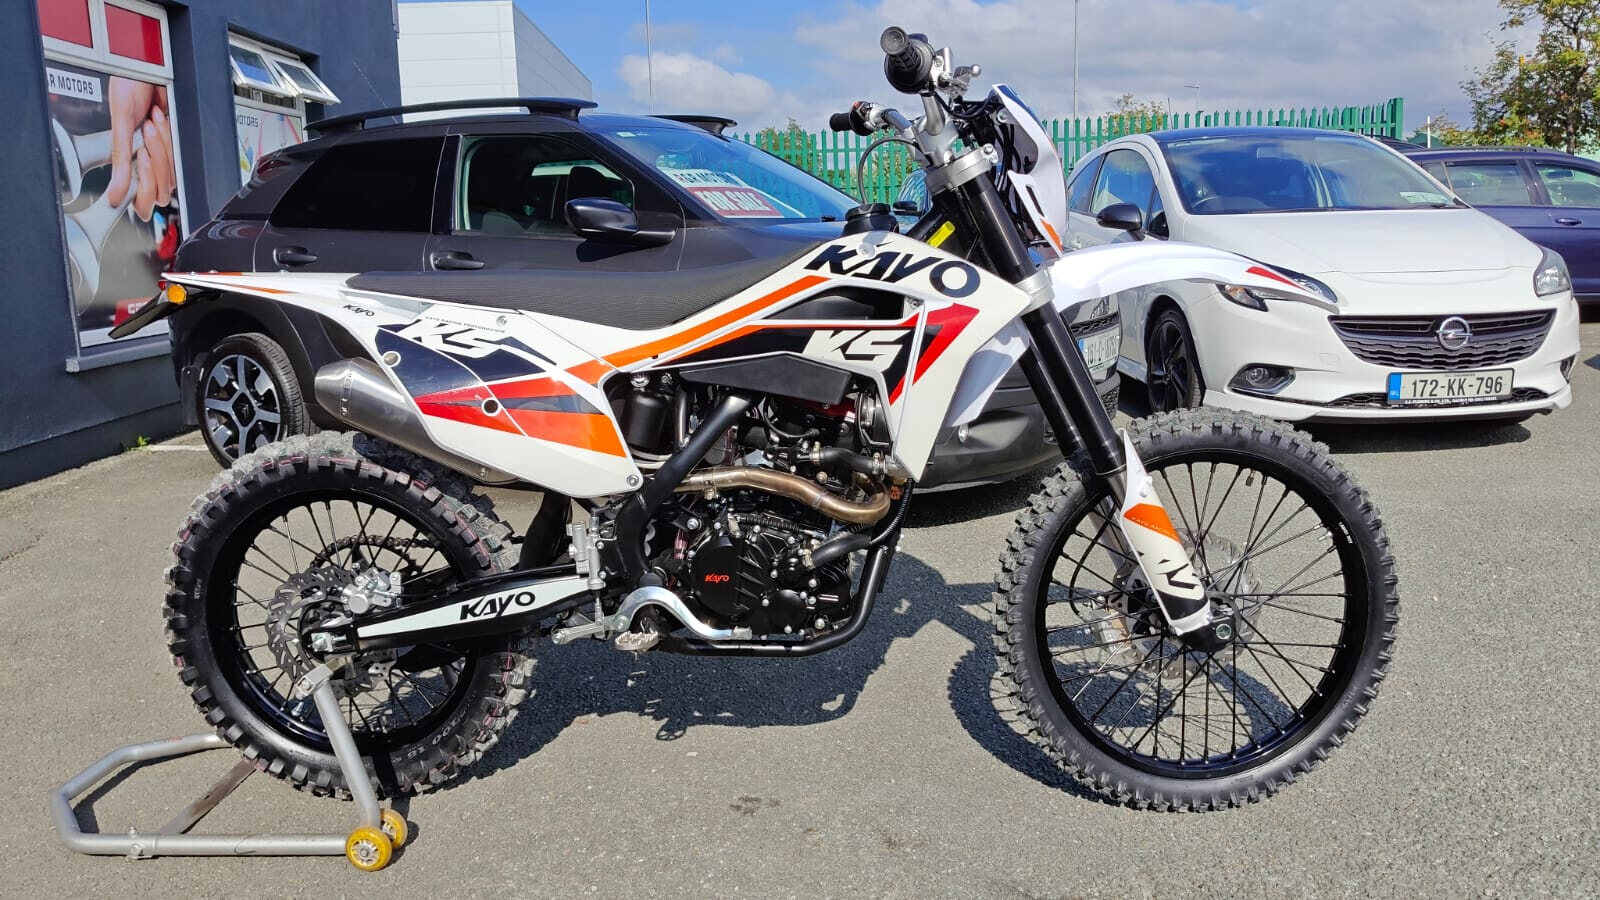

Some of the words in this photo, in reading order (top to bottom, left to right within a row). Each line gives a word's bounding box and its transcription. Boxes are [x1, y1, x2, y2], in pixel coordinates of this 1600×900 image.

[57, 75, 94, 95] MOTORS
[694, 190, 740, 212] FOR
[724, 190, 772, 212] SALE
[343, 304, 375, 317] KAYO
[1412, 375, 1504, 398] 172-KK-796
[705, 573, 730, 584] KAYO
[460, 591, 536, 621] KAYO
